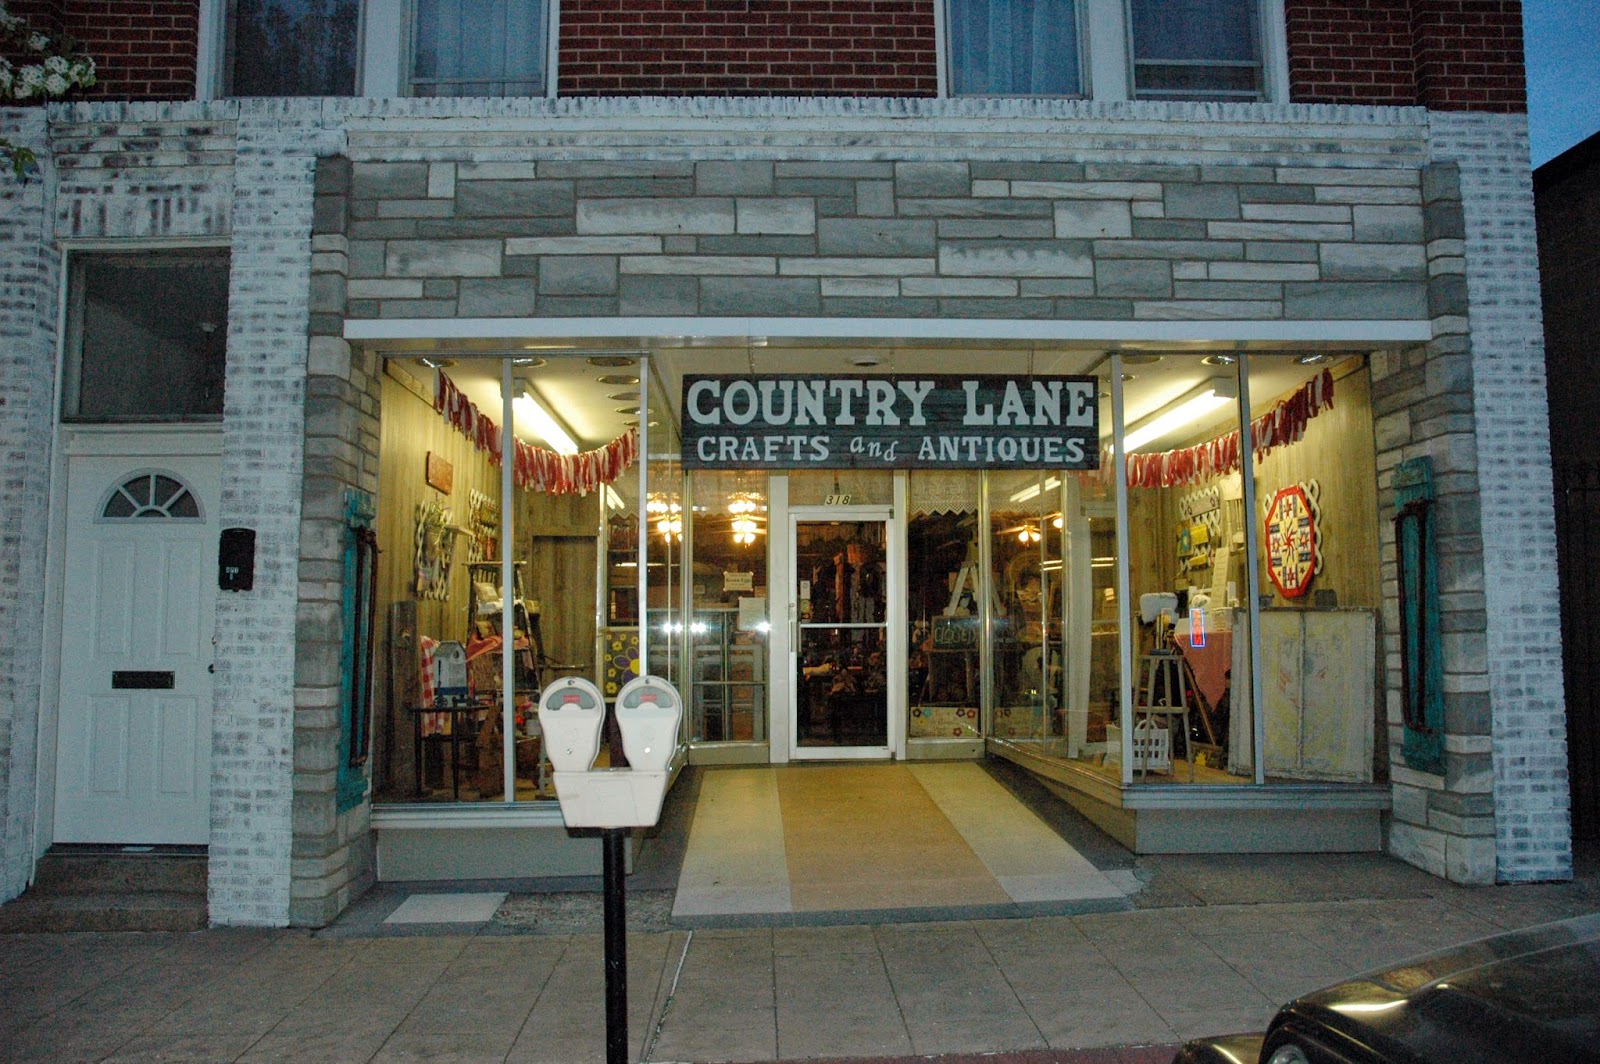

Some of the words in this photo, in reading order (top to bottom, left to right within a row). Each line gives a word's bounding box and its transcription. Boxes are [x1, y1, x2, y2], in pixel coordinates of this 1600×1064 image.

[686, 379, 935, 427] COUNTRY
[961, 380, 1095, 427] LANE
[696, 435, 830, 462] CRAFTS
[849, 436, 899, 463] and
[918, 436, 1086, 463] ANTIQUES
[826, 495, 850, 505] 318
[934, 624, 976, 645] CLOSED
